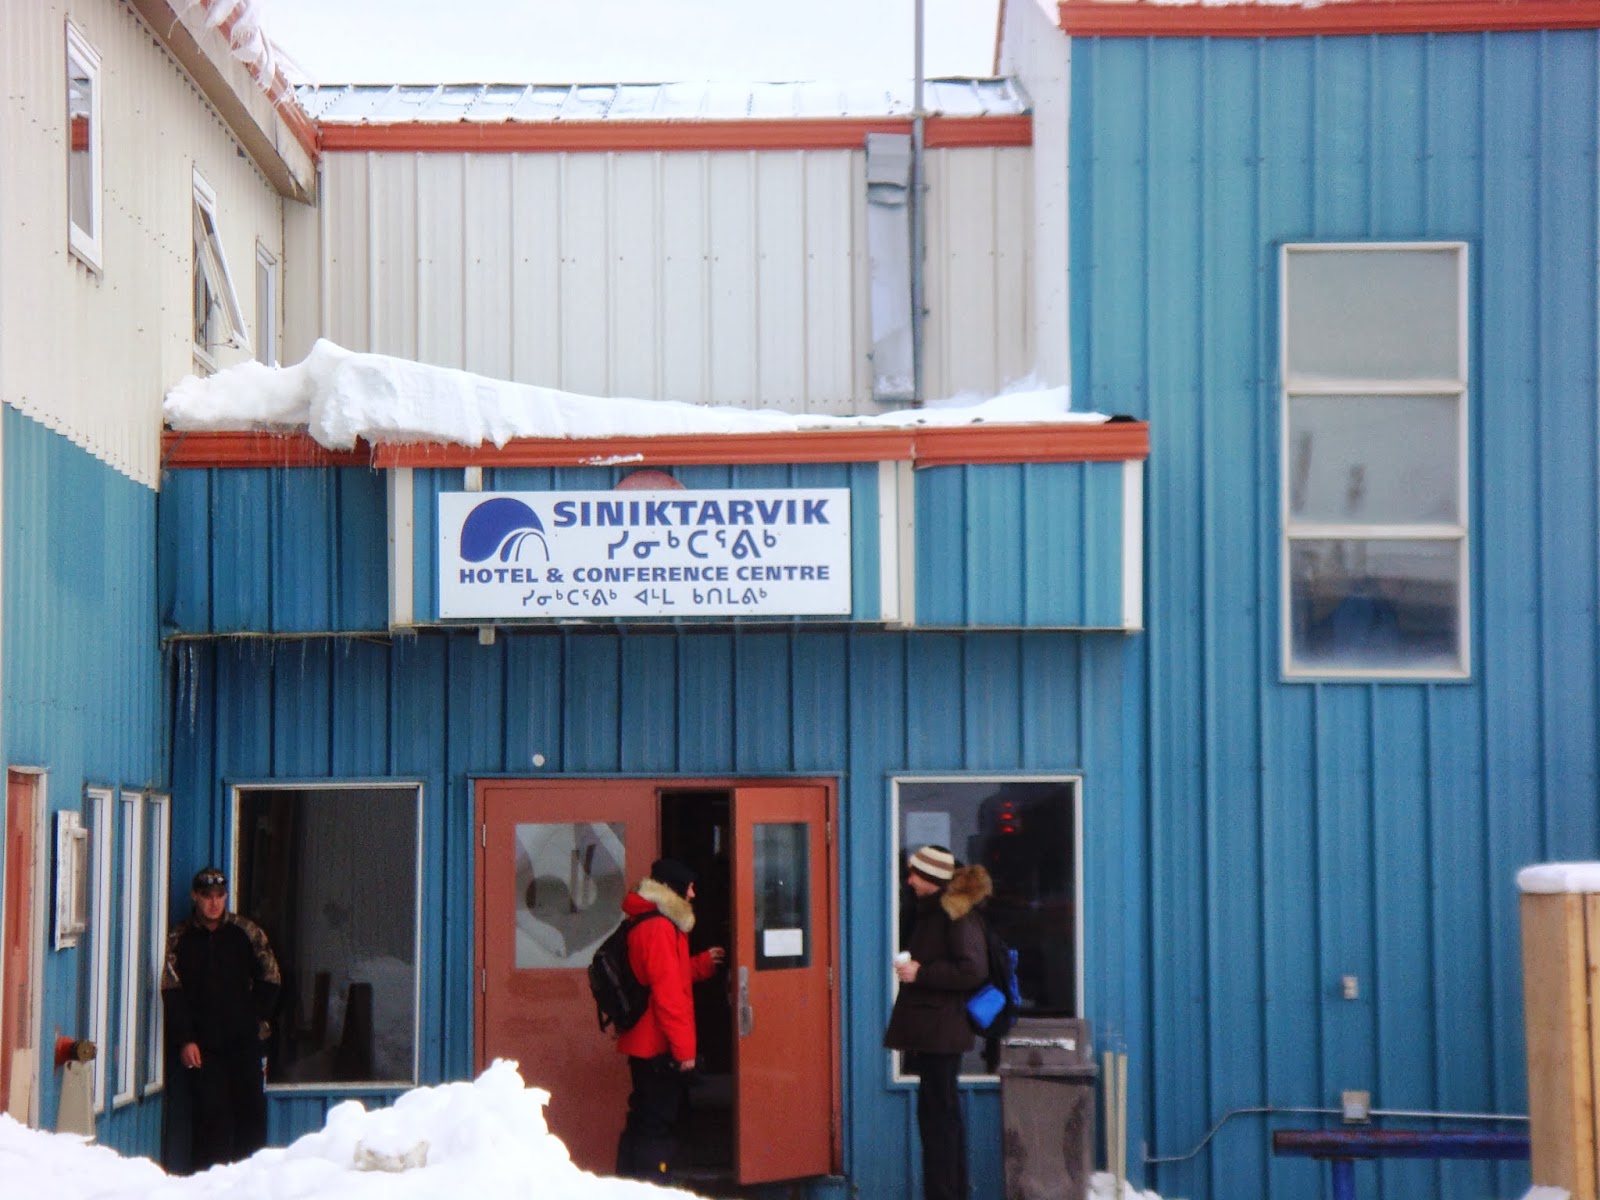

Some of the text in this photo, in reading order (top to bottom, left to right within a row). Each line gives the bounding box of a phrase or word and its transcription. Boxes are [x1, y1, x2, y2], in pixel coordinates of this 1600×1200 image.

[553, 499, 831, 527] SINIKTARVIK
[459, 565, 830, 584] HOTEL & CONFERENCE CENTRE
